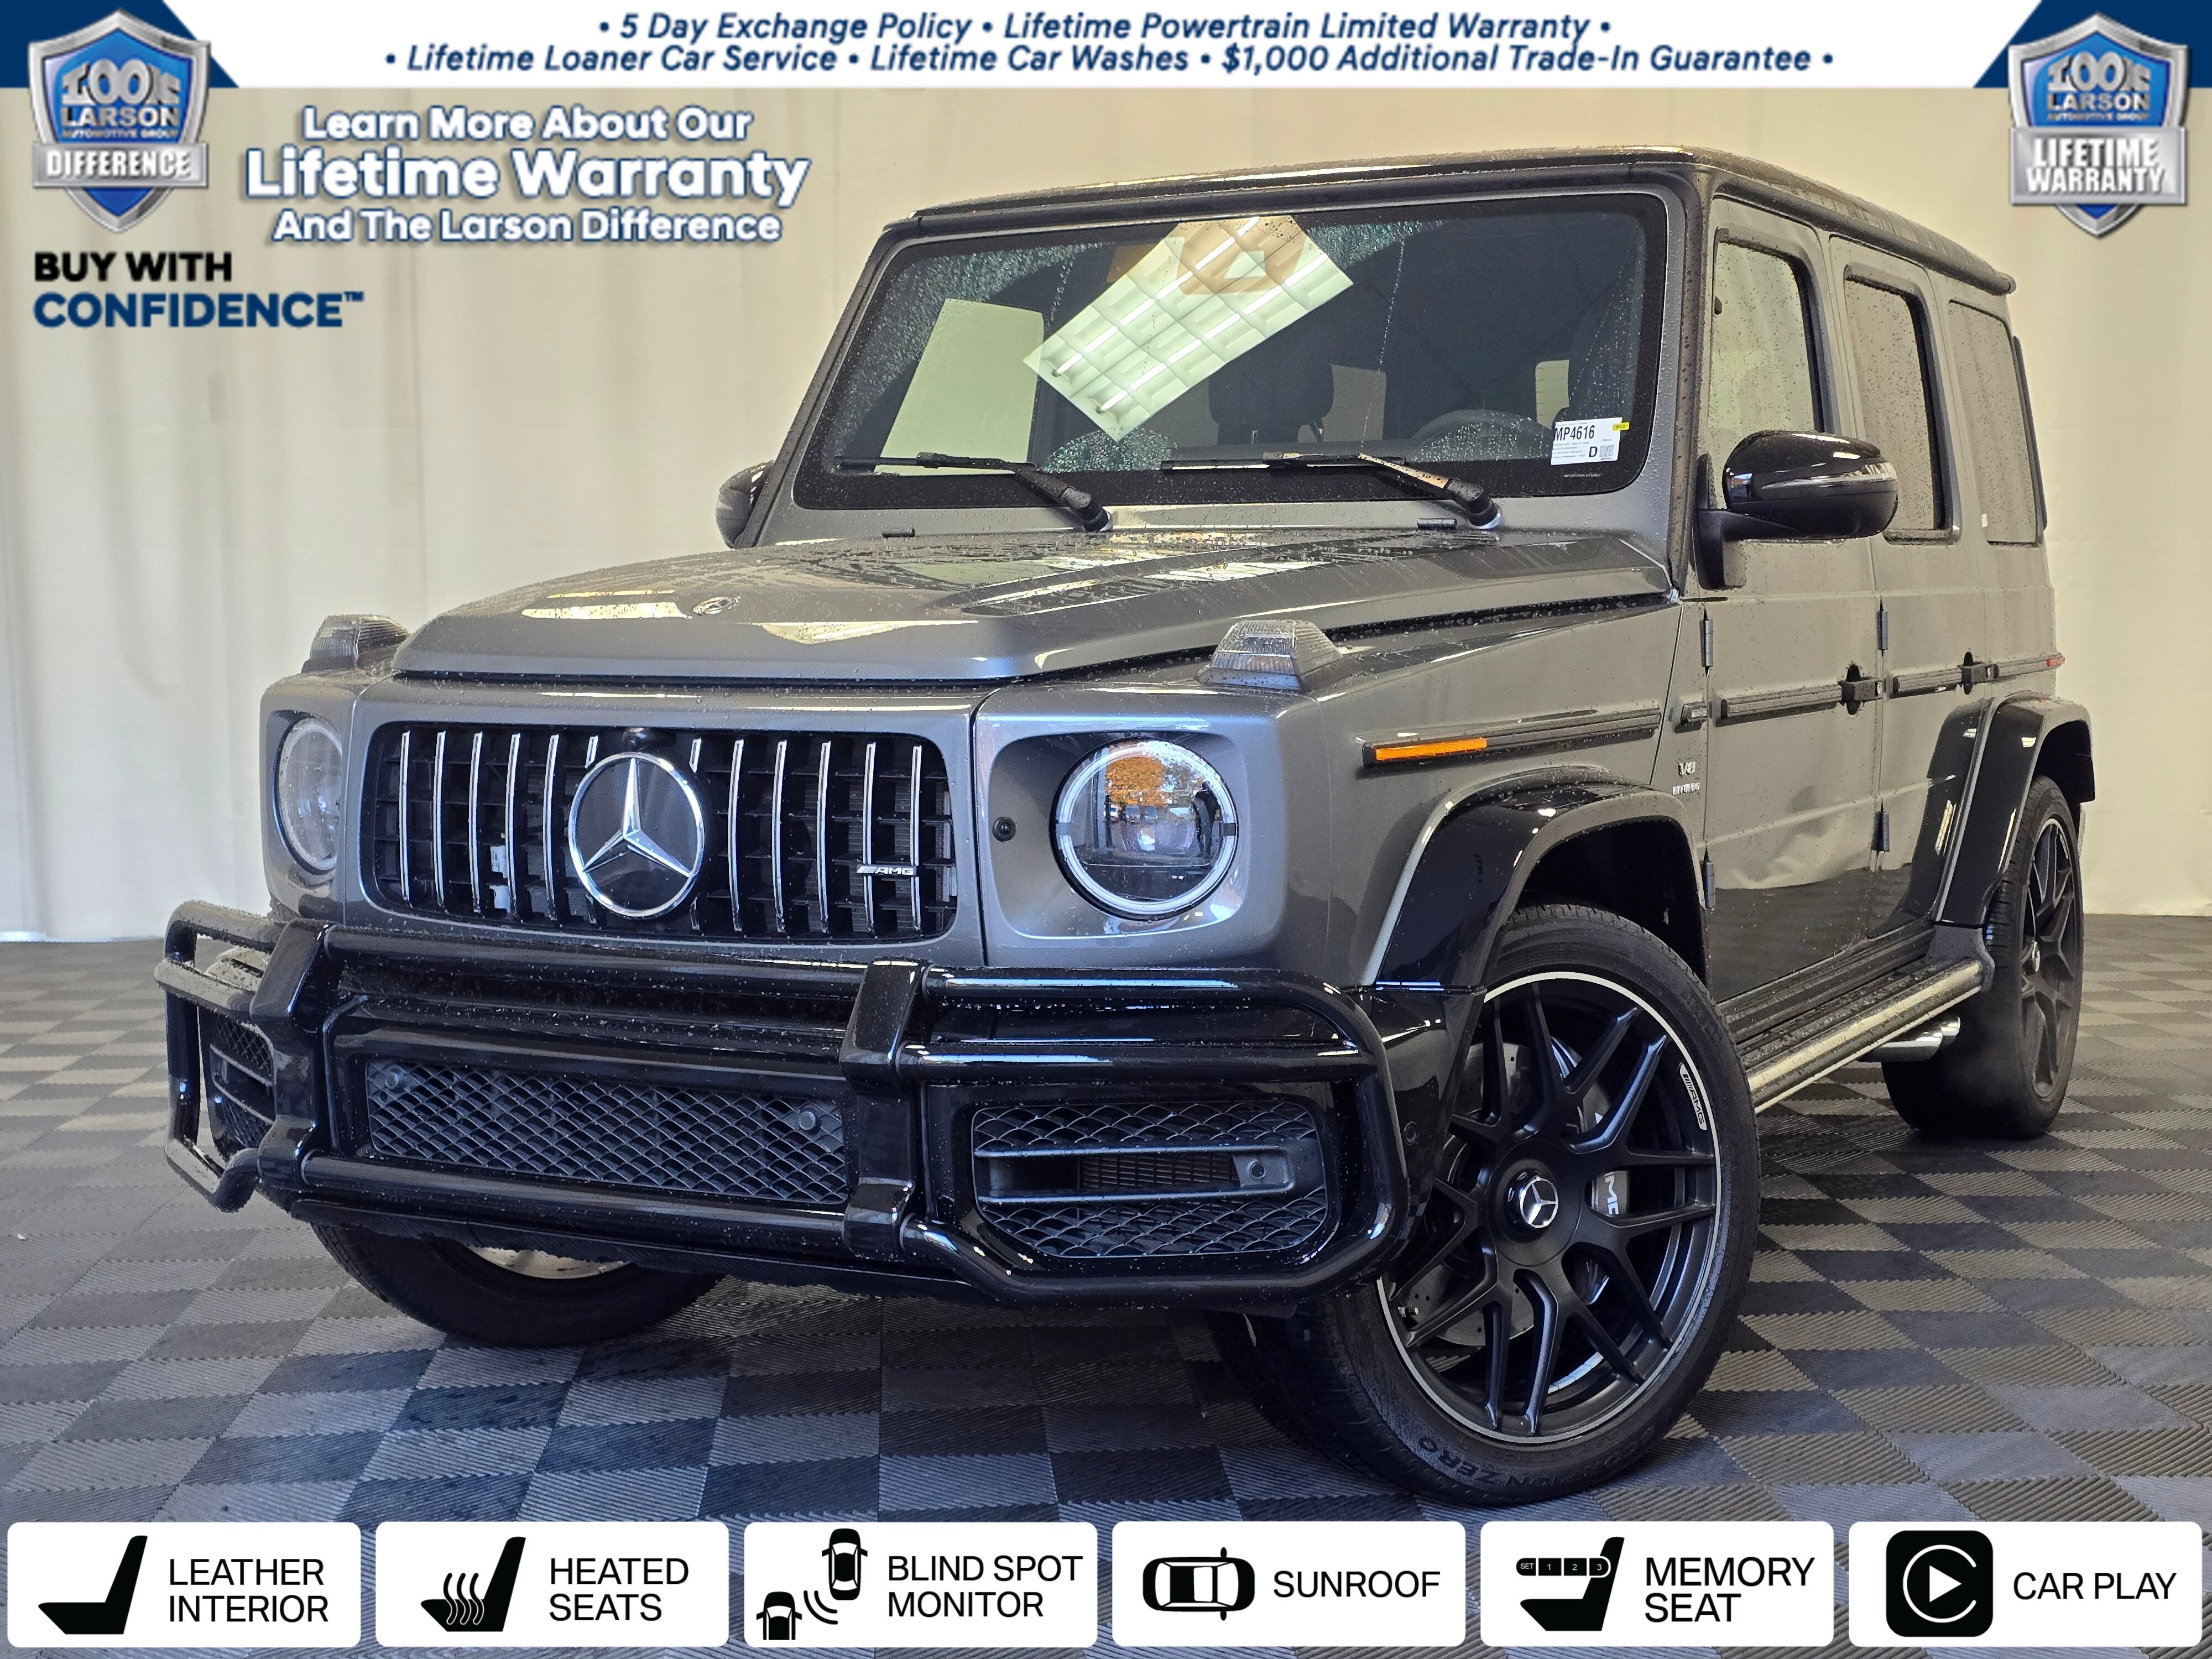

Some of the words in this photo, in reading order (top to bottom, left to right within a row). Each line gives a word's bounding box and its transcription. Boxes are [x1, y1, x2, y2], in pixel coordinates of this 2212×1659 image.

[1555, 425, 1595, 441] MP4616
[1588, 446, 1598, 458] D
[1678, 761, 1696, 776] V8
[874, 867, 915, 875] AMG
